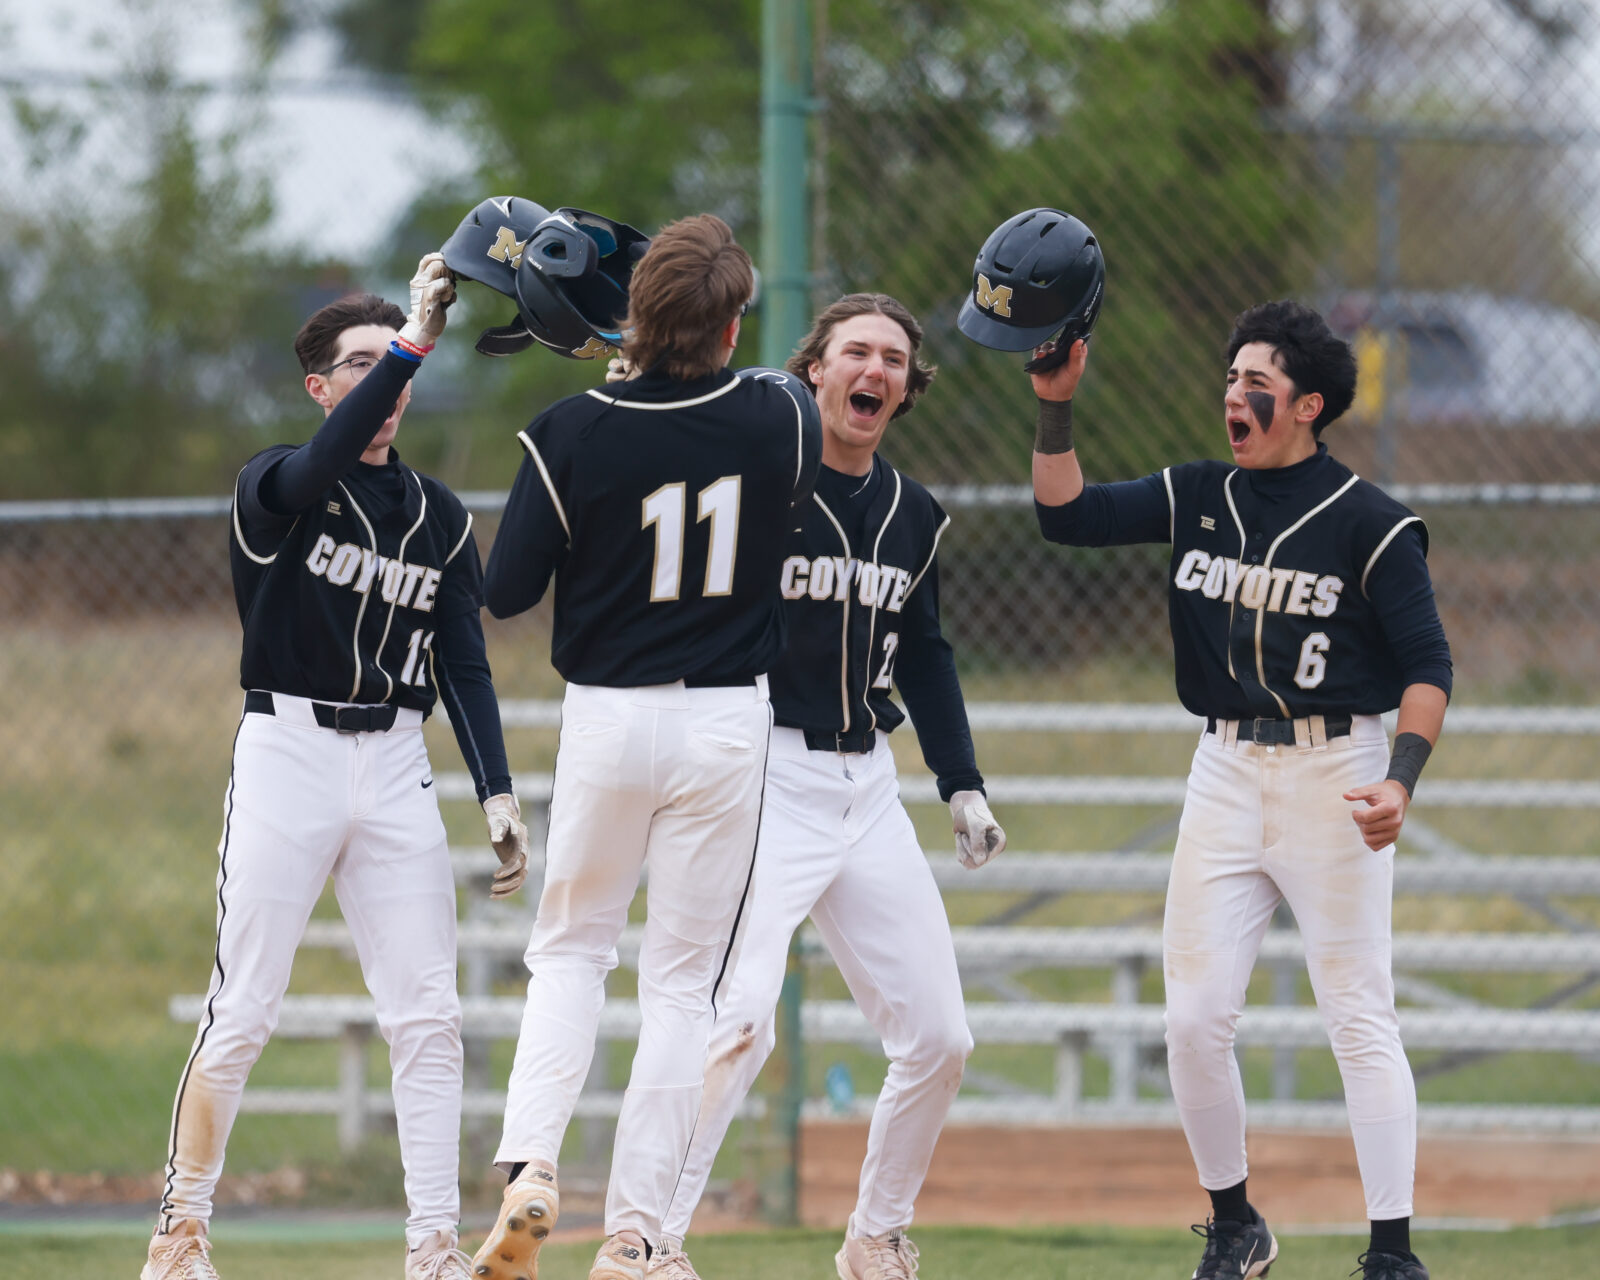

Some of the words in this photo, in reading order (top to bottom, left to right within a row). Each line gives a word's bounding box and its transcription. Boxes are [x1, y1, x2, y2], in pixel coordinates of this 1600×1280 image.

[486, 225, 528, 270] M
[976, 272, 1014, 318] M
[641, 474, 742, 603] 11
[305, 532, 443, 613] COYOTE
[779, 554, 911, 613] COYOTE
[1174, 548, 1345, 618] COYOTES
[1293, 631, 1331, 690] 6
